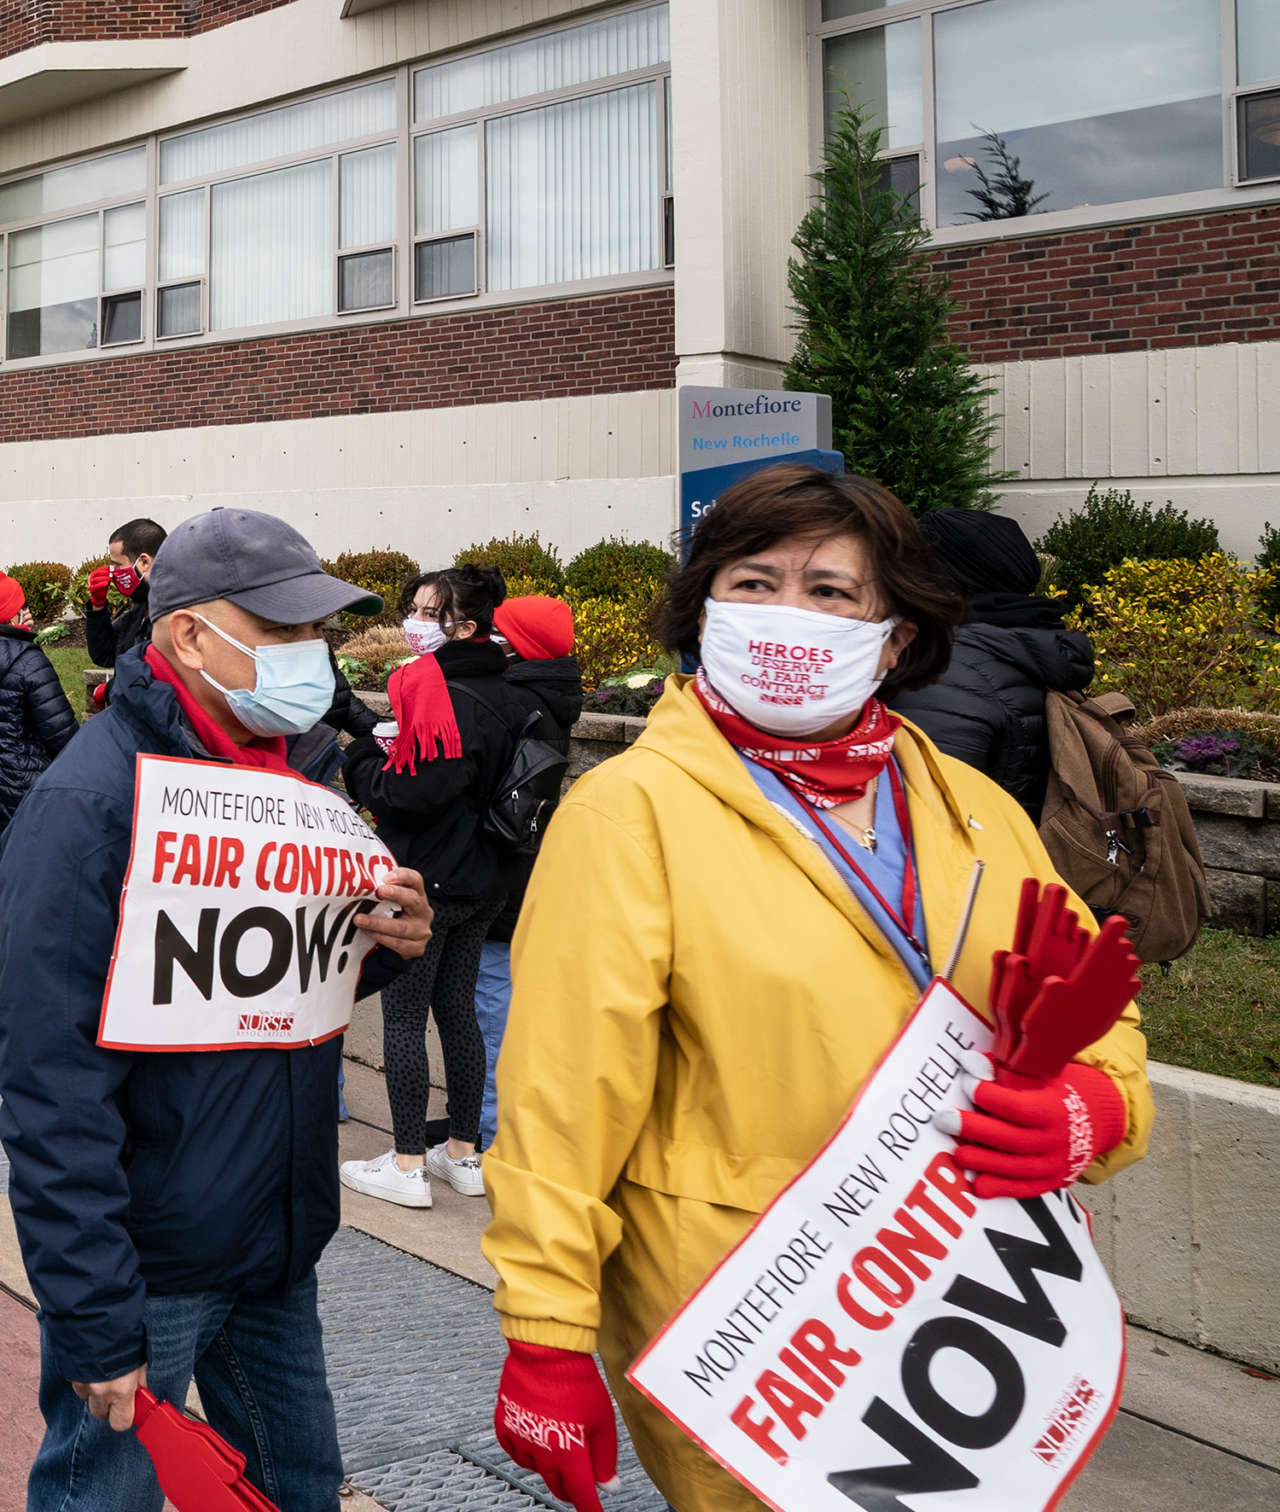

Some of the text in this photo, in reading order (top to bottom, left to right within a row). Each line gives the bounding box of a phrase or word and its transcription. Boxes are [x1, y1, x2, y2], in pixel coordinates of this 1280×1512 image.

[692, 394, 802, 419] Montefiore
[693, 431, 800, 450] New Rochelle
[748, 639, 834, 663] HEROES
[751, 655, 825, 674] DESERVE
[740, 674, 830, 695] CONTRACT
[759, 669, 811, 684] A FAIR
[161, 786, 381, 841] MONTEFIORE NEW ROCHEL
[152, 830, 245, 889] FAIR
[152, 898, 379, 1005] NOW!
[238, 1014, 295, 1031] NURSES
[682, 1021, 975, 1397] MONTEFIORE NEW ROCHELLE
[729, 1151, 978, 1467] FAIR CONTR
[826, 1188, 1084, 1512] NOW
[1030, 1379, 1095, 1465] NURSES
